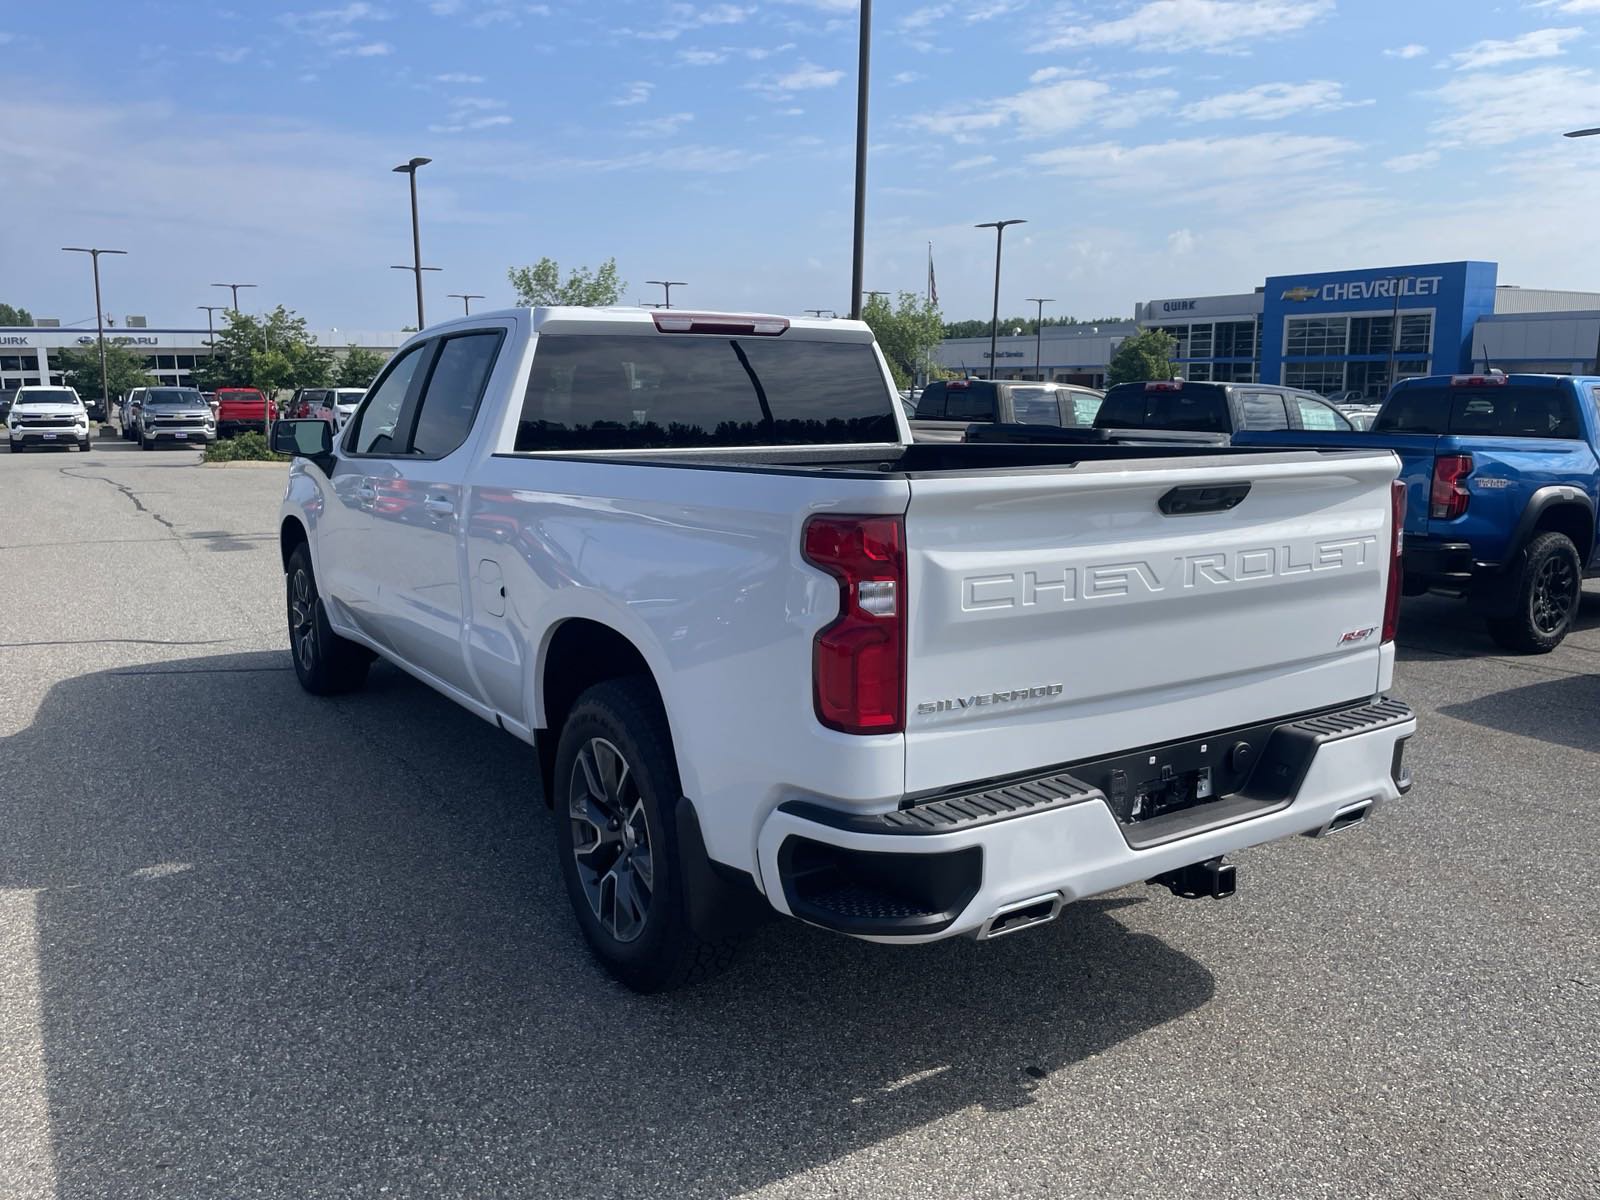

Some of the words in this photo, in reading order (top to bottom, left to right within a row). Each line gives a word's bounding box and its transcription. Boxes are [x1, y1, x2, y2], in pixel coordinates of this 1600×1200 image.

[1322, 276, 1443, 301] CHEVROLET
[1163, 300, 1197, 313] QUIRK
[961, 535, 1377, 612] CHEVROLET
[1335, 626, 1380, 647] RST
[917, 682, 1063, 715] SILVERADO
